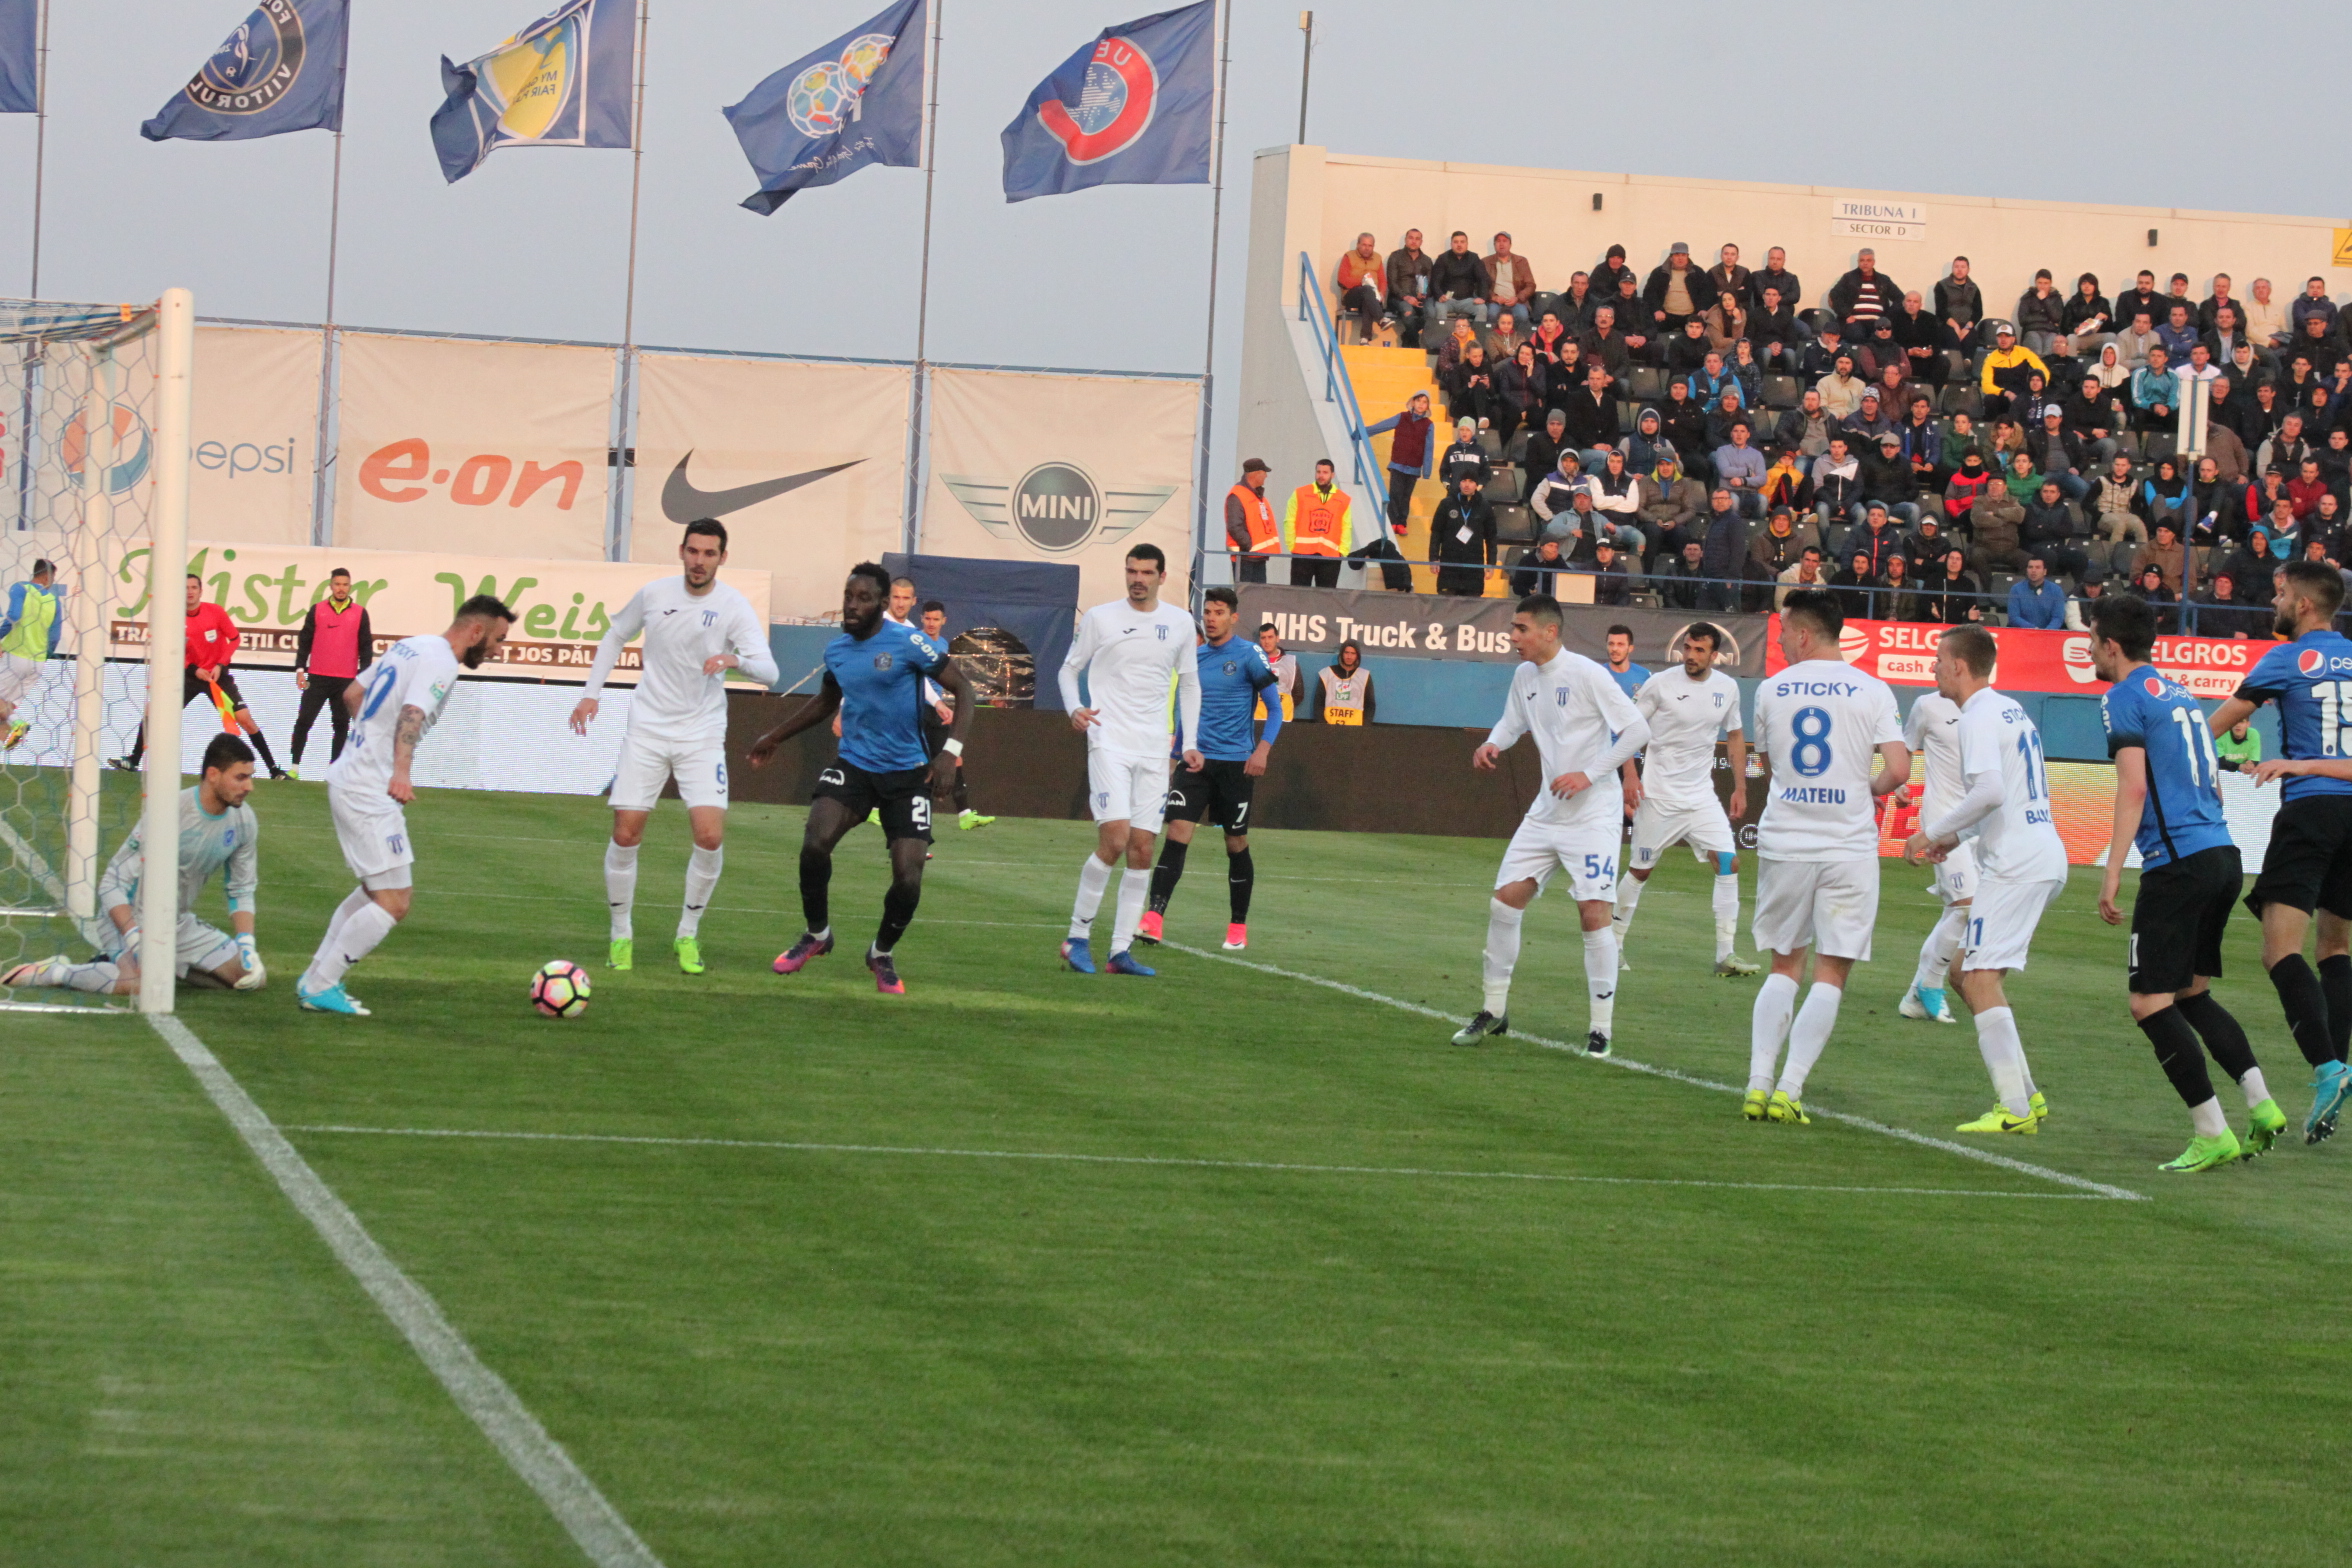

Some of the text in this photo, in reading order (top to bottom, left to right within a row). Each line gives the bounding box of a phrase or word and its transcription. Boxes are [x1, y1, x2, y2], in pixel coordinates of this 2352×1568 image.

[1842, 203, 1916, 218] TRIBUNA I
[1849, 223, 1906, 236] SECTOR D
[188, 437, 296, 479] epsi
[1021, 493, 1091, 521] MINI
[434, 572, 643, 643] Weis
[1261, 611, 1511, 654] MHS Truck & Bus
[1878, 626, 1998, 650] SELG
[515, 646, 552, 662] JOS
[2151, 641, 2248, 666] ELGROS
[2330, 656, 2352, 672] pe
[1887, 660, 1924, 673] cash
[1775, 681, 1859, 698] STICKY
[2178, 674, 2190, 687] &
[2193, 676, 2237, 693] carry
[1329, 708, 1355, 719] STAFF
[1790, 705, 1833, 779] 8
[2171, 705, 2219, 789] 11
[716, 763, 727, 785] 6
[1780, 786, 1847, 805] MATEIU
[1237, 802, 1249, 823] 7
[1584, 853, 1615, 882] 54
